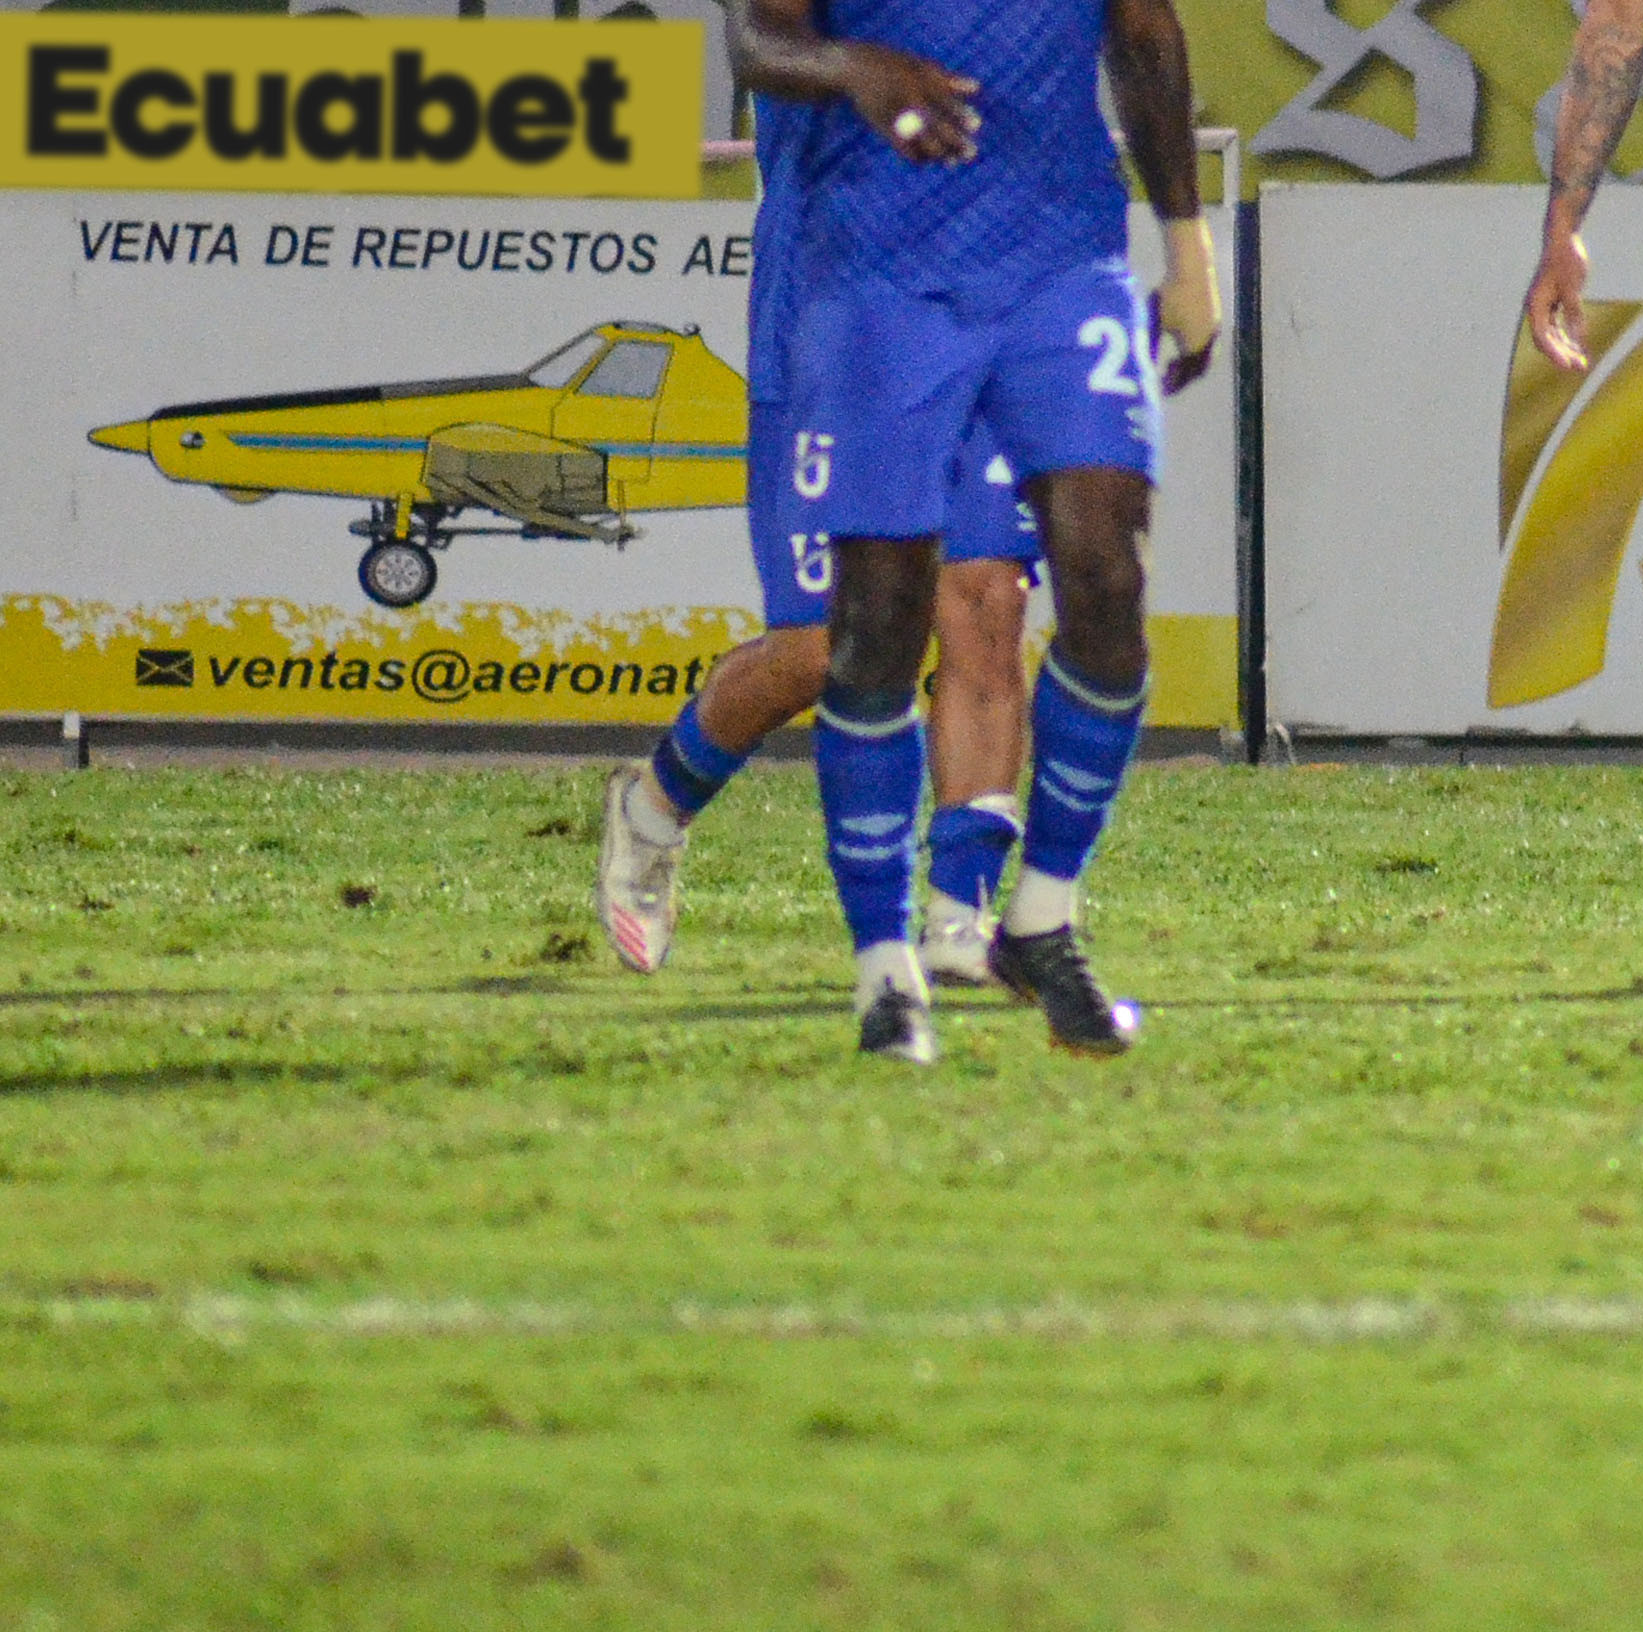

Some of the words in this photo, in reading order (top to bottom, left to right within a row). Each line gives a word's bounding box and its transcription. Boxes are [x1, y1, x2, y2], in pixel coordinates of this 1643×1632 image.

[26, 43, 632, 166] Ecuabet
[80, 220, 239, 265] VENTA
[265, 224, 334, 267] DE
[352, 226, 658, 275] REPUESTOS
[209, 649, 720, 703] ventas@aeronat
